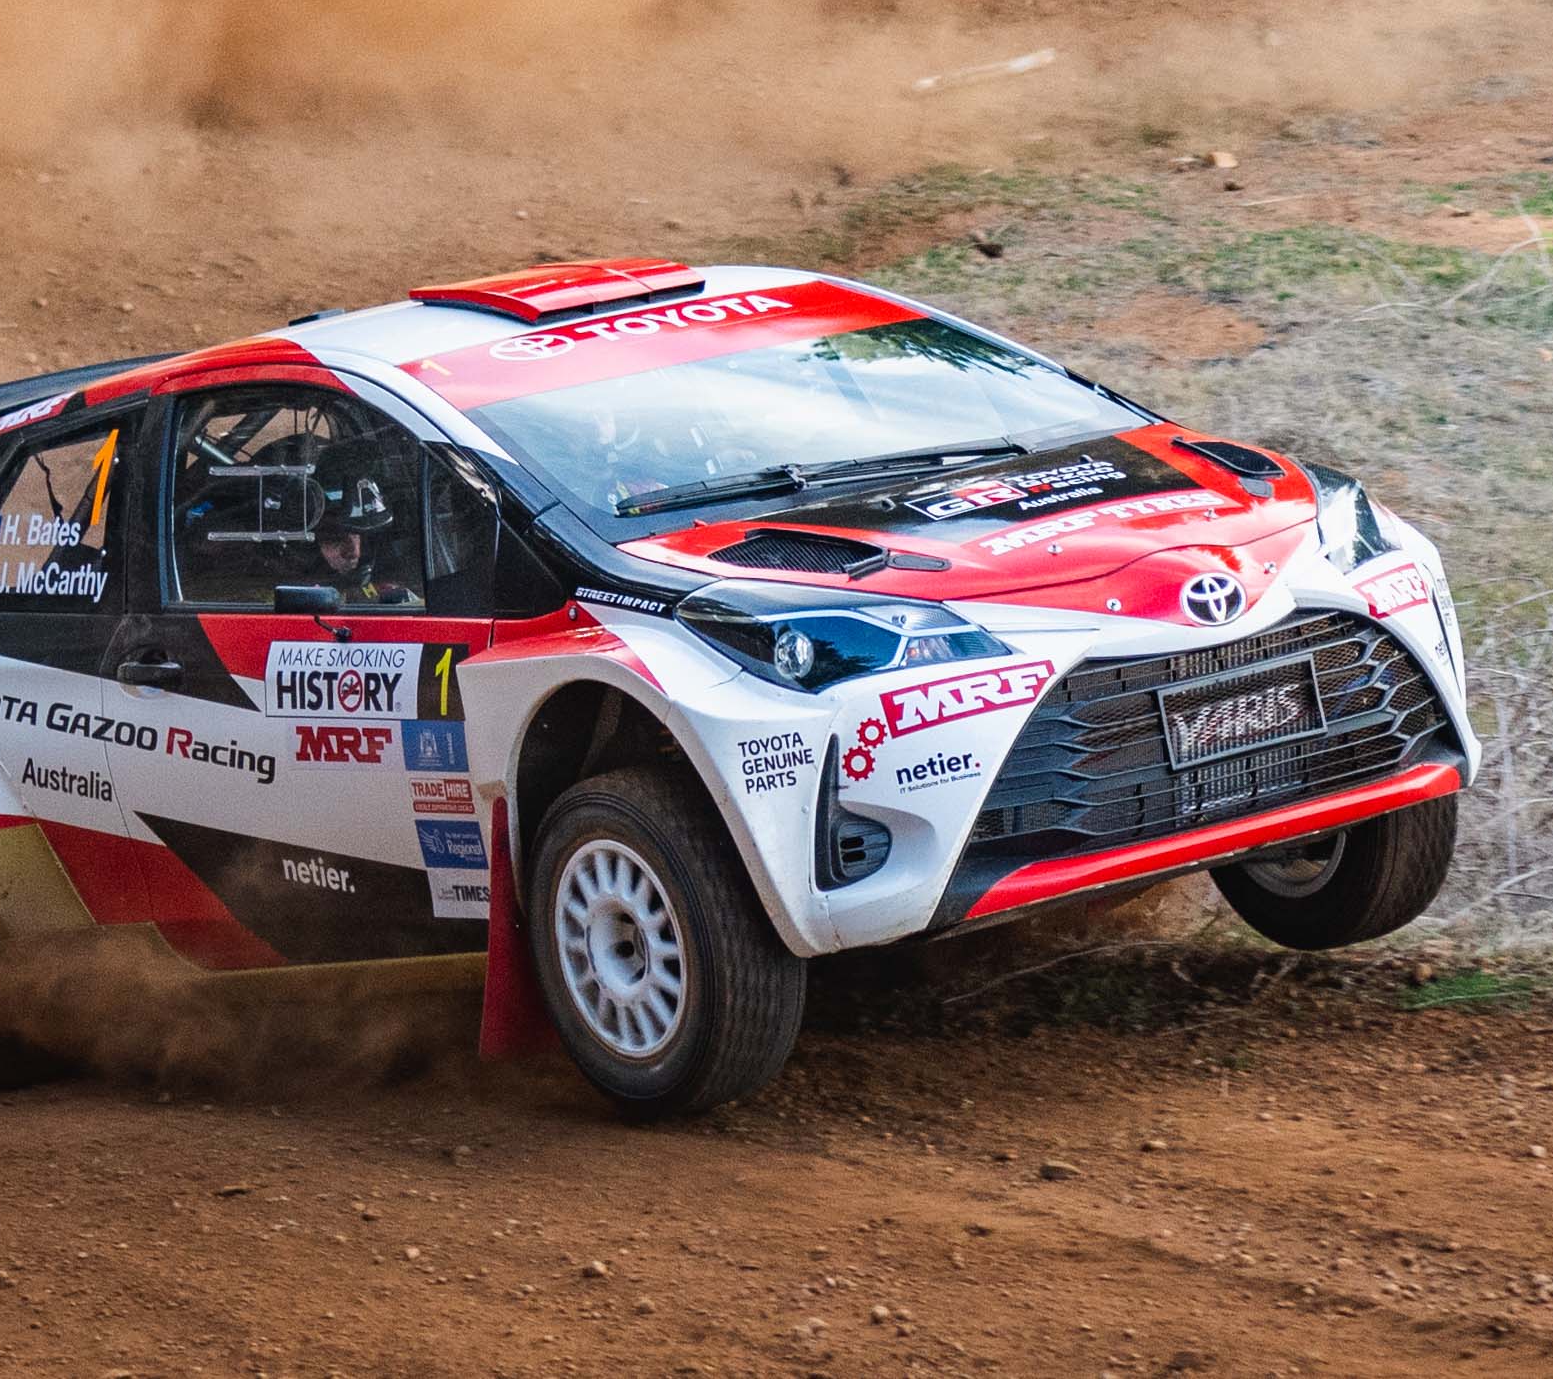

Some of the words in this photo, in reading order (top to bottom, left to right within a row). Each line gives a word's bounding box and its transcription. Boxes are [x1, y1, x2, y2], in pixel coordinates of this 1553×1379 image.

[575, 294, 792, 342] TOYOTA
[90, 429, 119, 525] 1
[1004, 462, 1114, 482] TOYOTA
[1017, 467, 1115, 488] GAZOO
[1028, 471, 1127, 494] Racing
[925, 487, 1019, 516] GR
[1018, 487, 1104, 511] Australia
[2, 513, 21, 546] H.
[27, 513, 81, 547] Bates
[979, 510, 1098, 556] MRF
[1096, 492, 1225, 520] TYRES
[16, 561, 109, 603] McCarthy
[1360, 570, 1425, 615] MRF
[277, 648, 328, 667] MAKE
[327, 648, 405, 668] SMOKING
[276, 669, 403, 713] HISTORY
[435, 647, 453, 716] 1
[892, 664, 1051, 730] MRF
[1172, 684, 1300, 752] YARIS
[46, 702, 158, 752] GAZOO
[165, 726, 276, 785] Racing
[295, 726, 393, 764] MRF
[737, 731, 804, 758] TOYOTA
[21, 757, 113, 802] Australia
[741, 748, 815, 776] GENUINE
[895, 752, 981, 785] netier.
[411, 782, 445, 798] TRADE
[446, 782, 470, 798] HIRE
[745, 770, 797, 794] PARTS
[282, 857, 355, 893] netier.
[452, 885, 491, 902] TIMES
